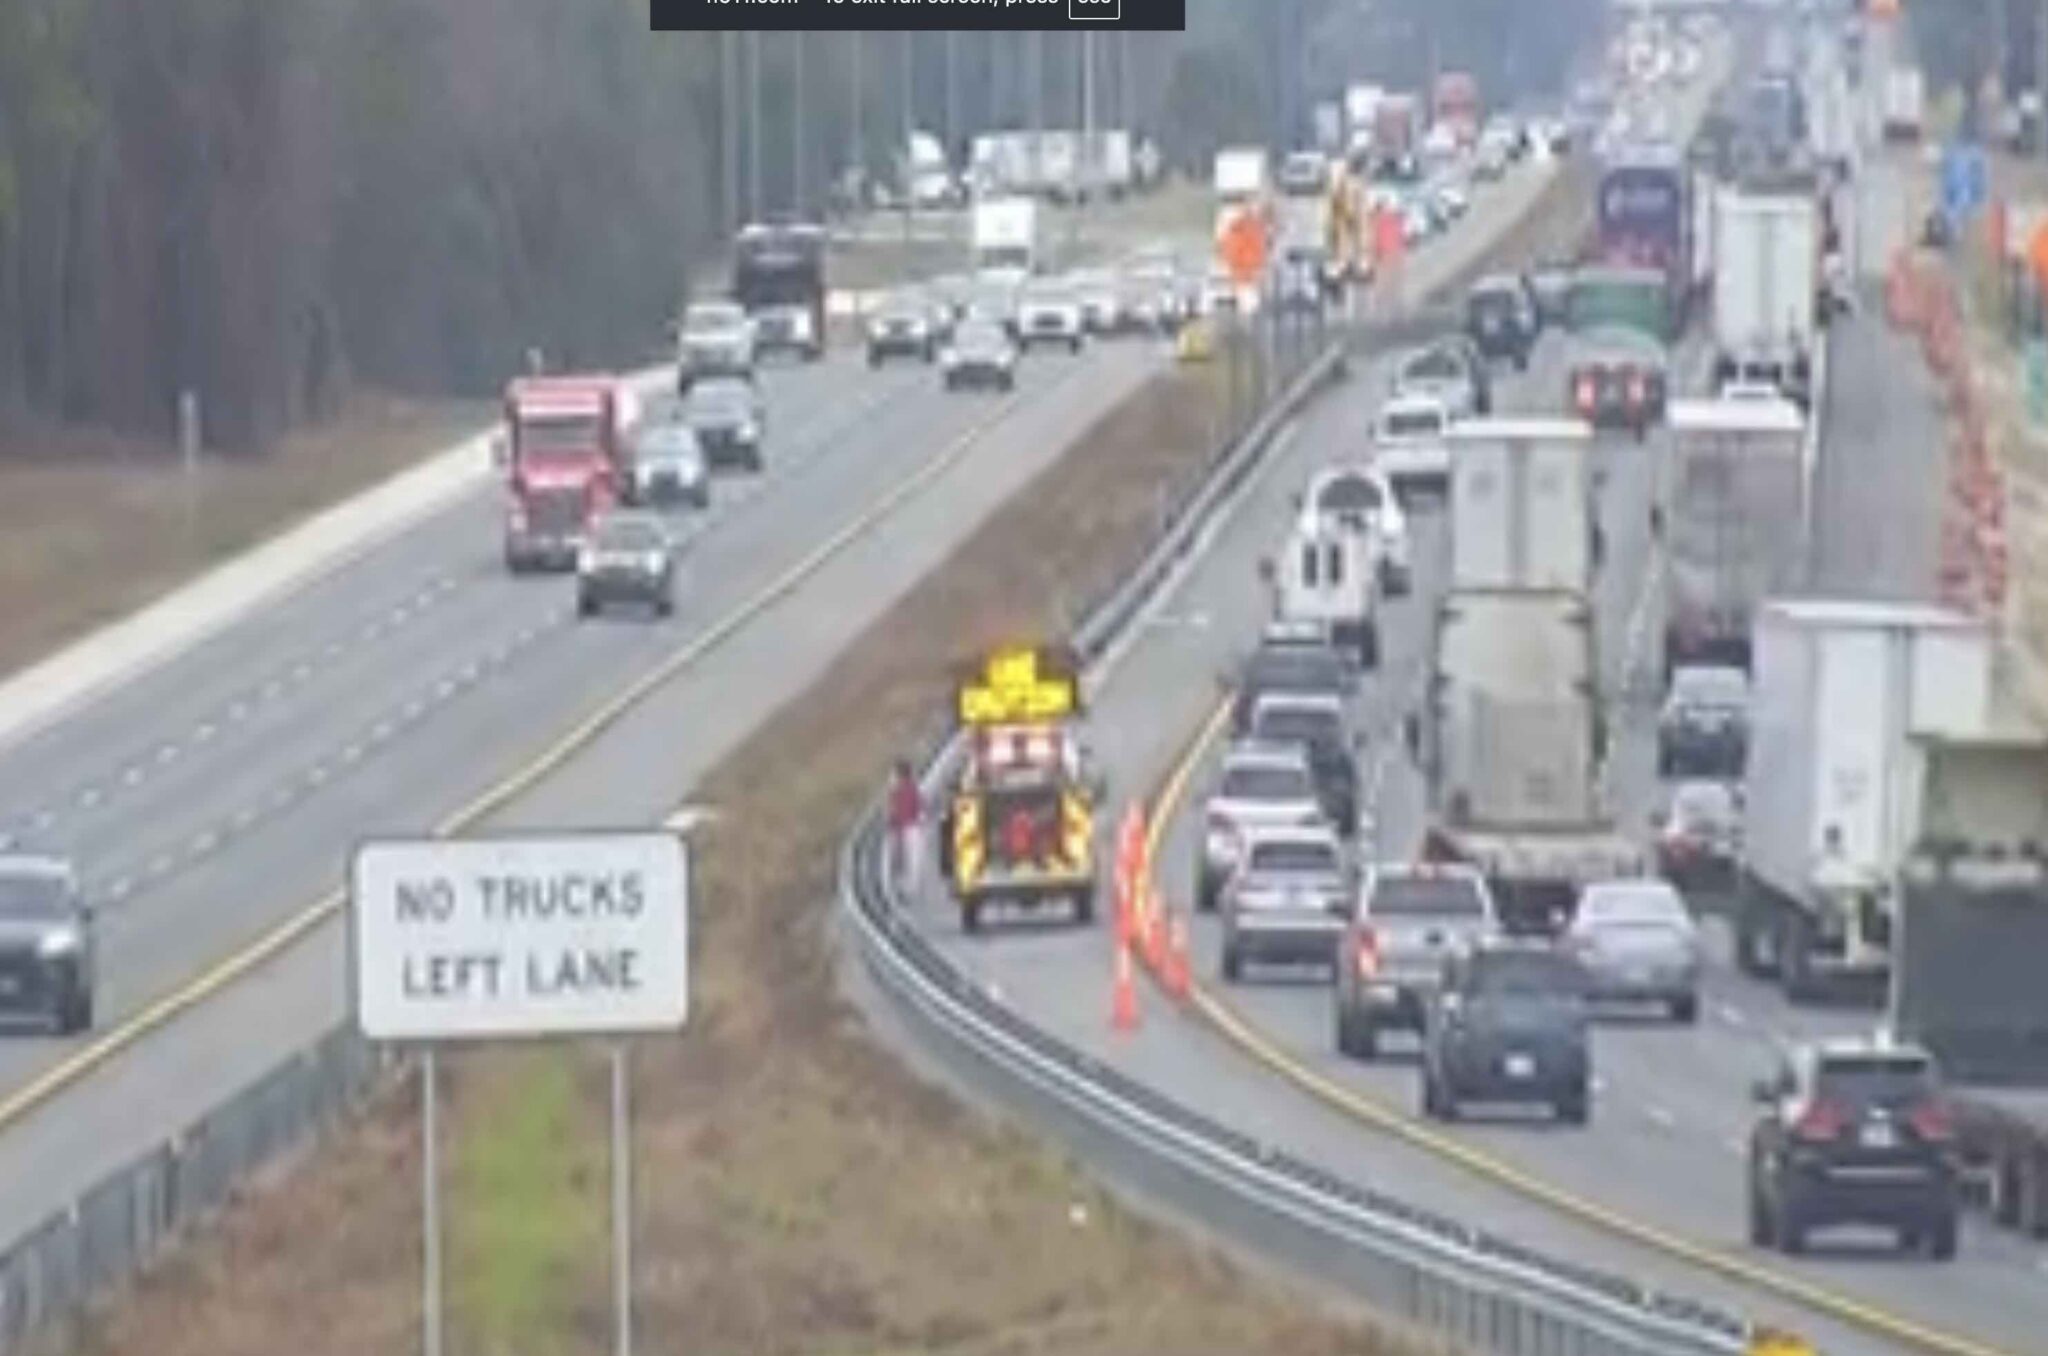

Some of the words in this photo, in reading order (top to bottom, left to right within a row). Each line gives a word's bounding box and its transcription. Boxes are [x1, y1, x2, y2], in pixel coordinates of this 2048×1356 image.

[395, 878, 455, 922] NO
[477, 872, 644, 920] TRUCKS
[402, 956, 501, 998] LEFT
[527, 950, 643, 997] LANE
